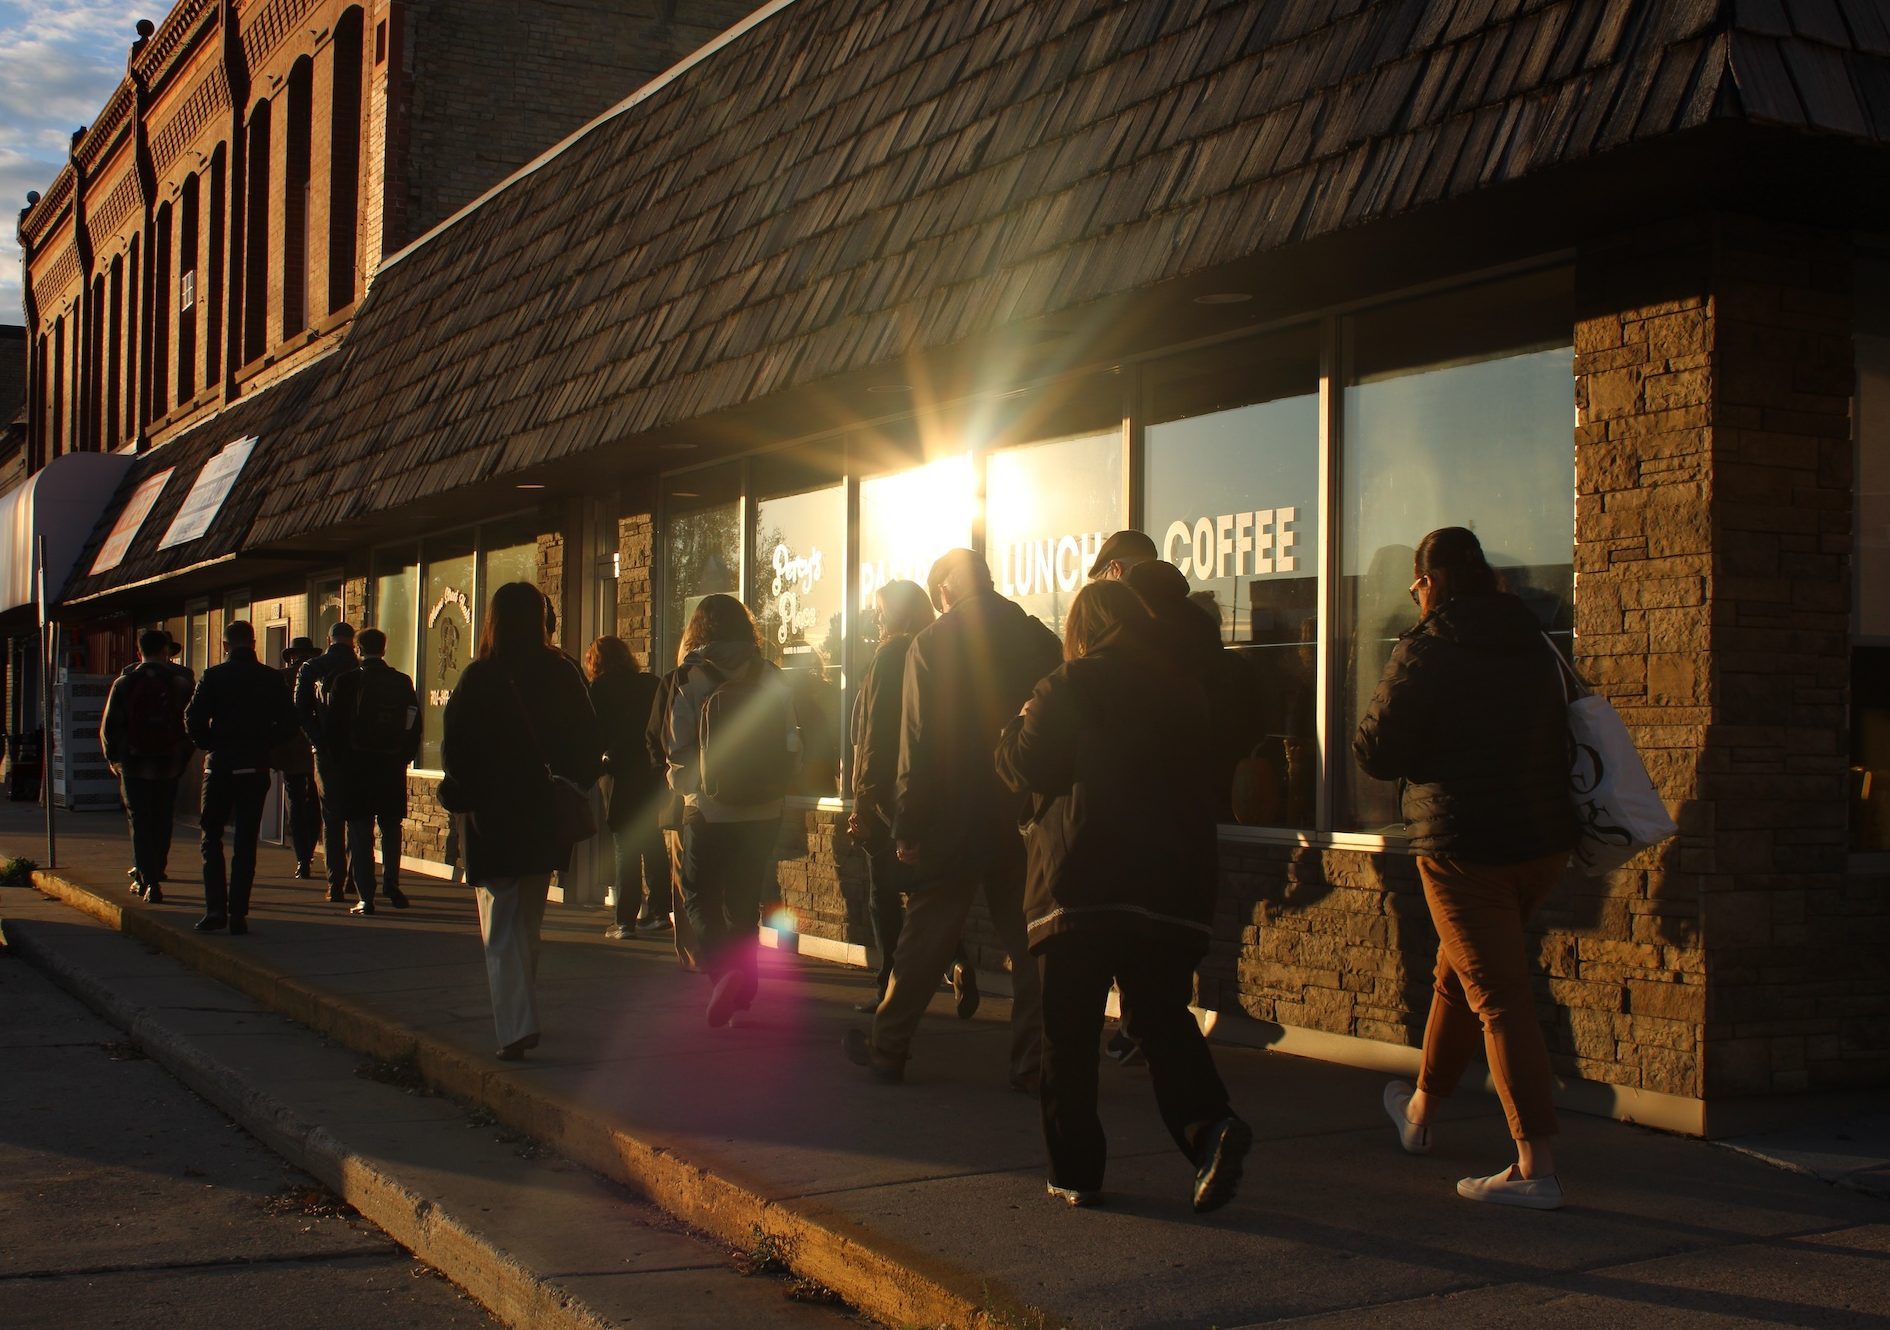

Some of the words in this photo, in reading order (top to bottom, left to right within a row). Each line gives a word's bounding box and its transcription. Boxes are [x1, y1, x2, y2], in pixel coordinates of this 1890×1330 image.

[1003, 532, 1101, 596] LUNCH
[1163, 506, 1295, 580] COFFEE
[778, 591, 816, 644] Place
